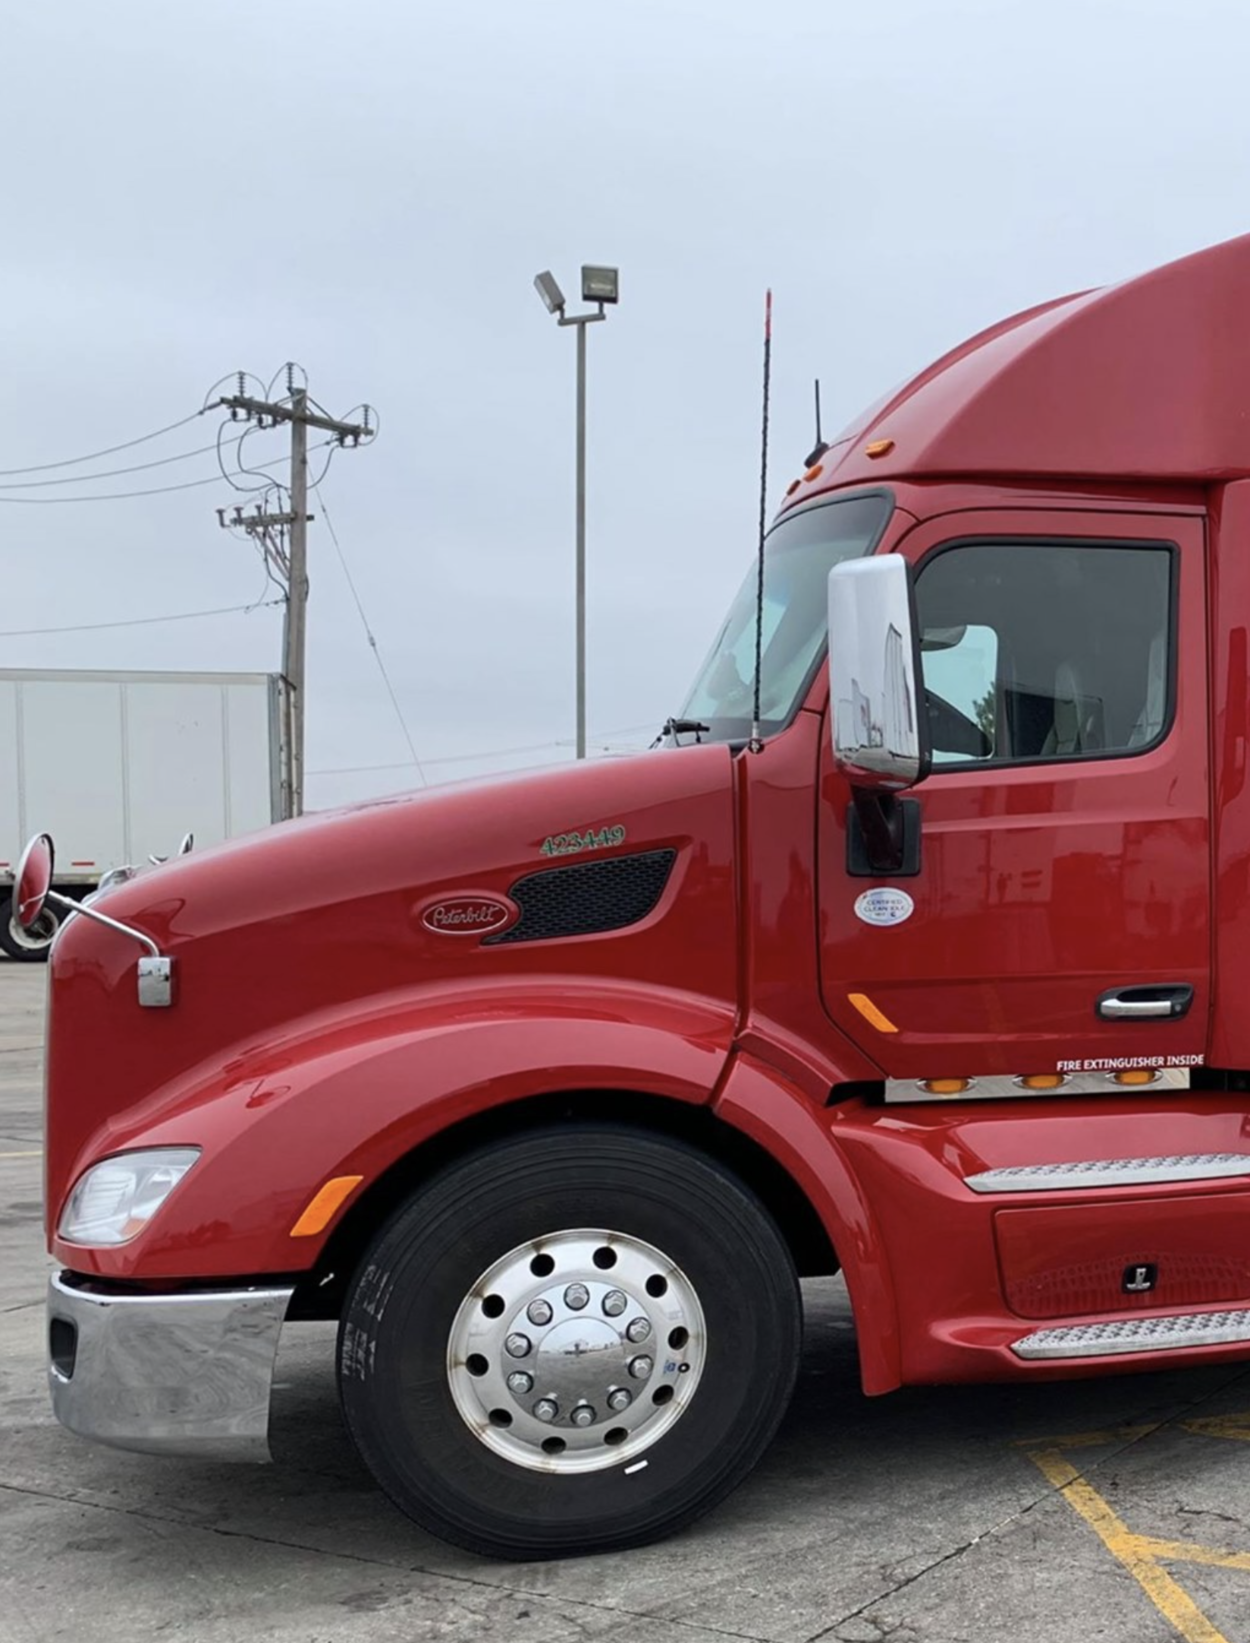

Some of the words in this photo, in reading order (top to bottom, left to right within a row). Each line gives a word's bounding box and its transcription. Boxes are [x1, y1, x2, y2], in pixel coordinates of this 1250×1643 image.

[539, 824, 626, 857] 423449
[432, 905, 499, 926] Peterbilt
[1056, 1060, 1081, 1071] FIRE
[1084, 1056, 1164, 1070] EXTINGUISHER
[1167, 1054, 1205, 1065] INSIDE
